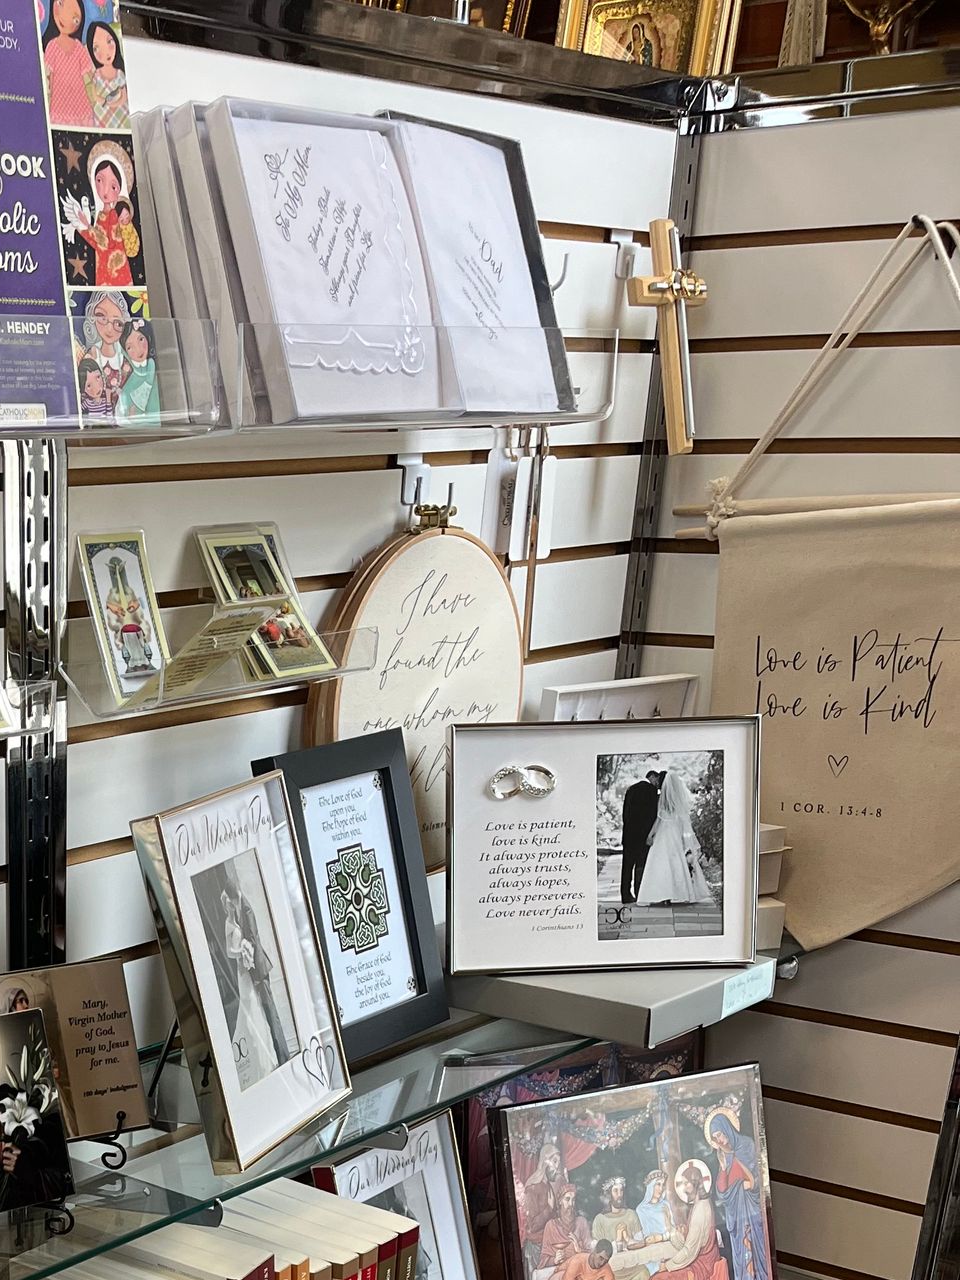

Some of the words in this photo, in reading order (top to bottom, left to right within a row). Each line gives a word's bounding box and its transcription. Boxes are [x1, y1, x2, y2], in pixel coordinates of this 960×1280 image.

[7, 320, 50, 336] HENDEY
[396, 569, 437, 635] I
[423, 573, 479, 617] have
[379, 635, 447, 690] found
[433, 627, 486, 678] the
[756, 635, 808, 677] Love
[817, 647, 843, 674] is
[851, 627, 952, 684] Patient
[756, 680, 808, 718] Love
[822, 693, 848, 720] is
[859, 661, 943, 735] Kind
[362, 718, 398, 731] one
[403, 687, 464, 732] whom
[467, 701, 499, 723] my
[793, 802, 830, 814] COR.
[839, 805, 883, 818] 13:4-8
[176, 823, 202, 866] Our
[203, 811, 249, 853] Wedding
[248, 795, 273, 836] Day
[485, 820, 516, 832] Love
[517, 821, 528, 831] is
[529, 819, 577, 833] patient,
[491, 835, 517, 847] love
[519, 836, 529, 846] is
[531, 833, 561, 848] kind.
[479, 851, 491, 862] It
[494, 850, 537, 864] always
[538, 849, 589, 864] protects,
[488, 864, 532, 877] always
[534, 862, 572, 874] trusts,
[489, 878, 533, 890] always
[534, 876, 571, 890] hopes,
[478, 892, 522, 906] always
[523, 892, 586, 906] perseveres.
[485, 906, 516, 919] Love
[518, 907, 550, 918] never
[550, 904, 582, 920] fails.
[68, 1015, 95, 1027] Virgin
[97, 1010, 128, 1022] Mother
[84, 1029, 94, 1041] of
[75, 1046, 96, 1057] pray
[98, 1043, 106, 1051] to
[107, 1040, 129, 1052] Jesus
[90, 1058, 103, 1070] for
[105, 1056, 120, 1064] me.
